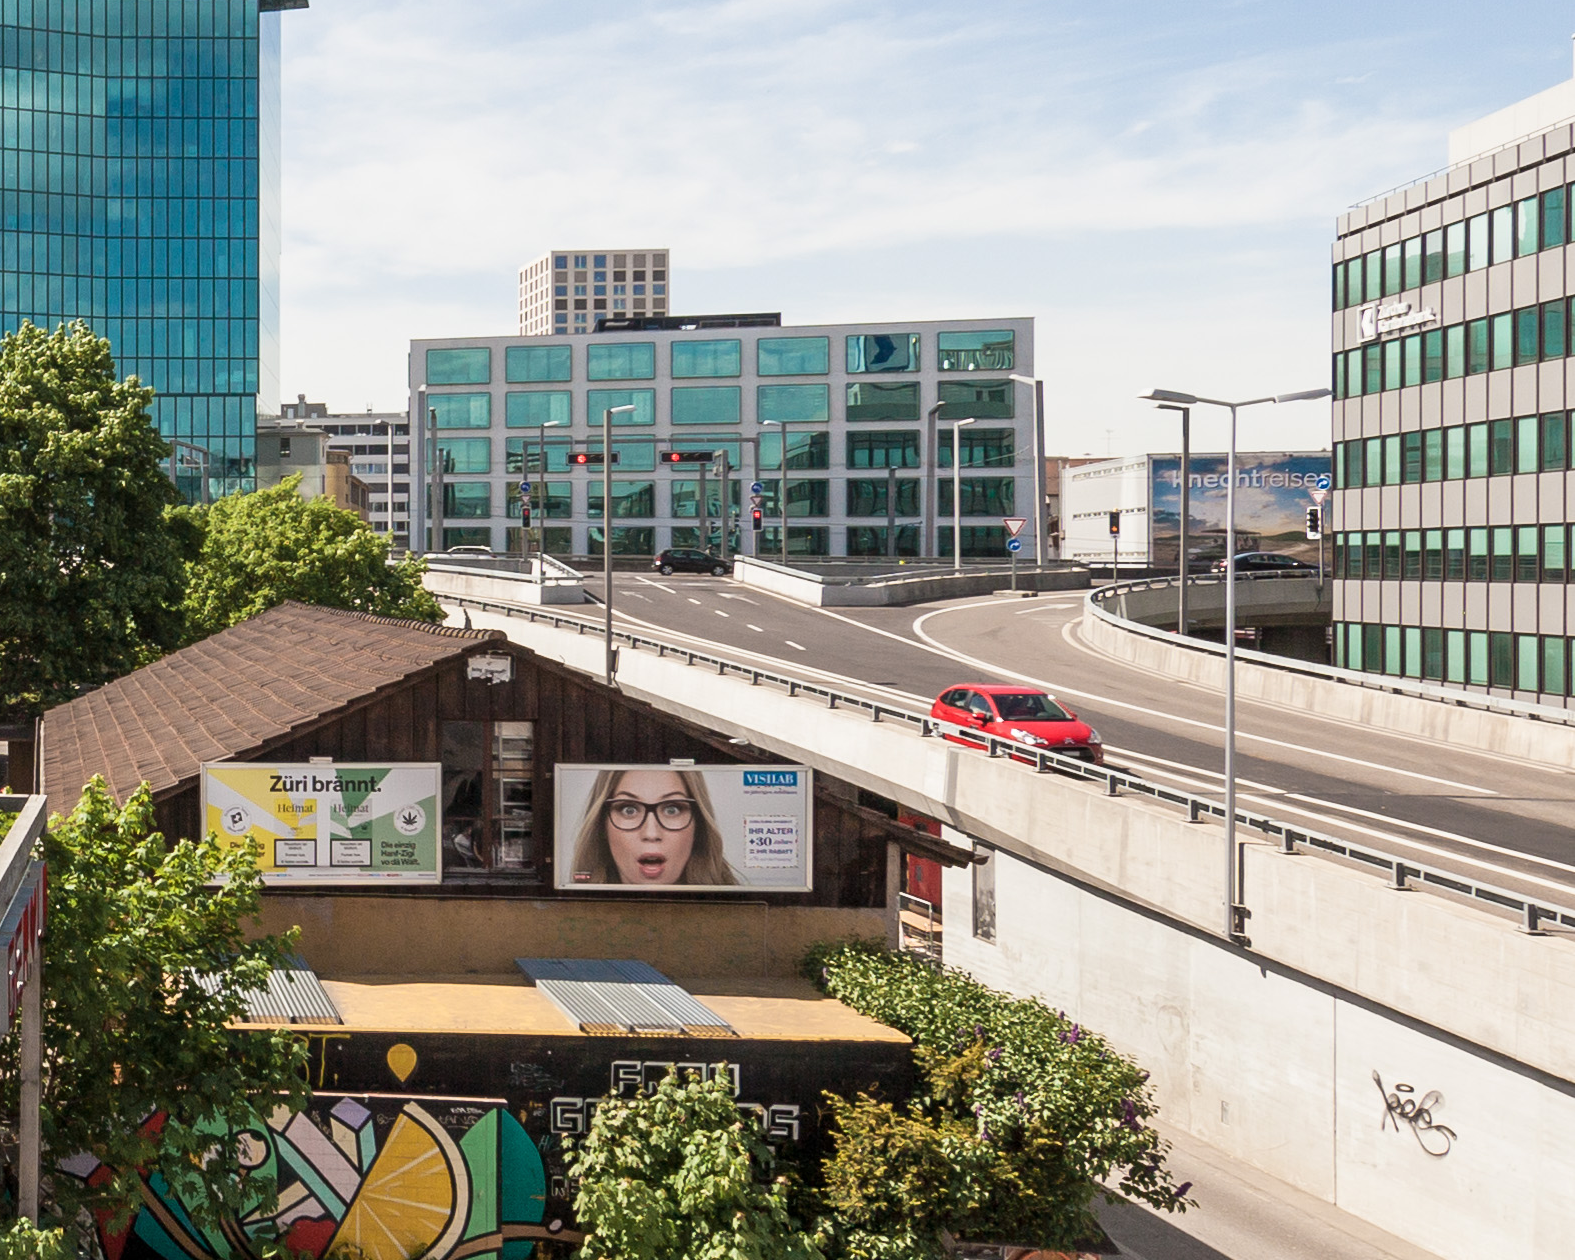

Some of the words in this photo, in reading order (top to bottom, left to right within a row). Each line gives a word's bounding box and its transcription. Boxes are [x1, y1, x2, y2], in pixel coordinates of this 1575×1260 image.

[270, 775, 307, 792] Züri
[312, 775, 382, 792] brännt.
[746, 774, 794, 784] VISILAB
[277, 803, 314, 813] Heimat
